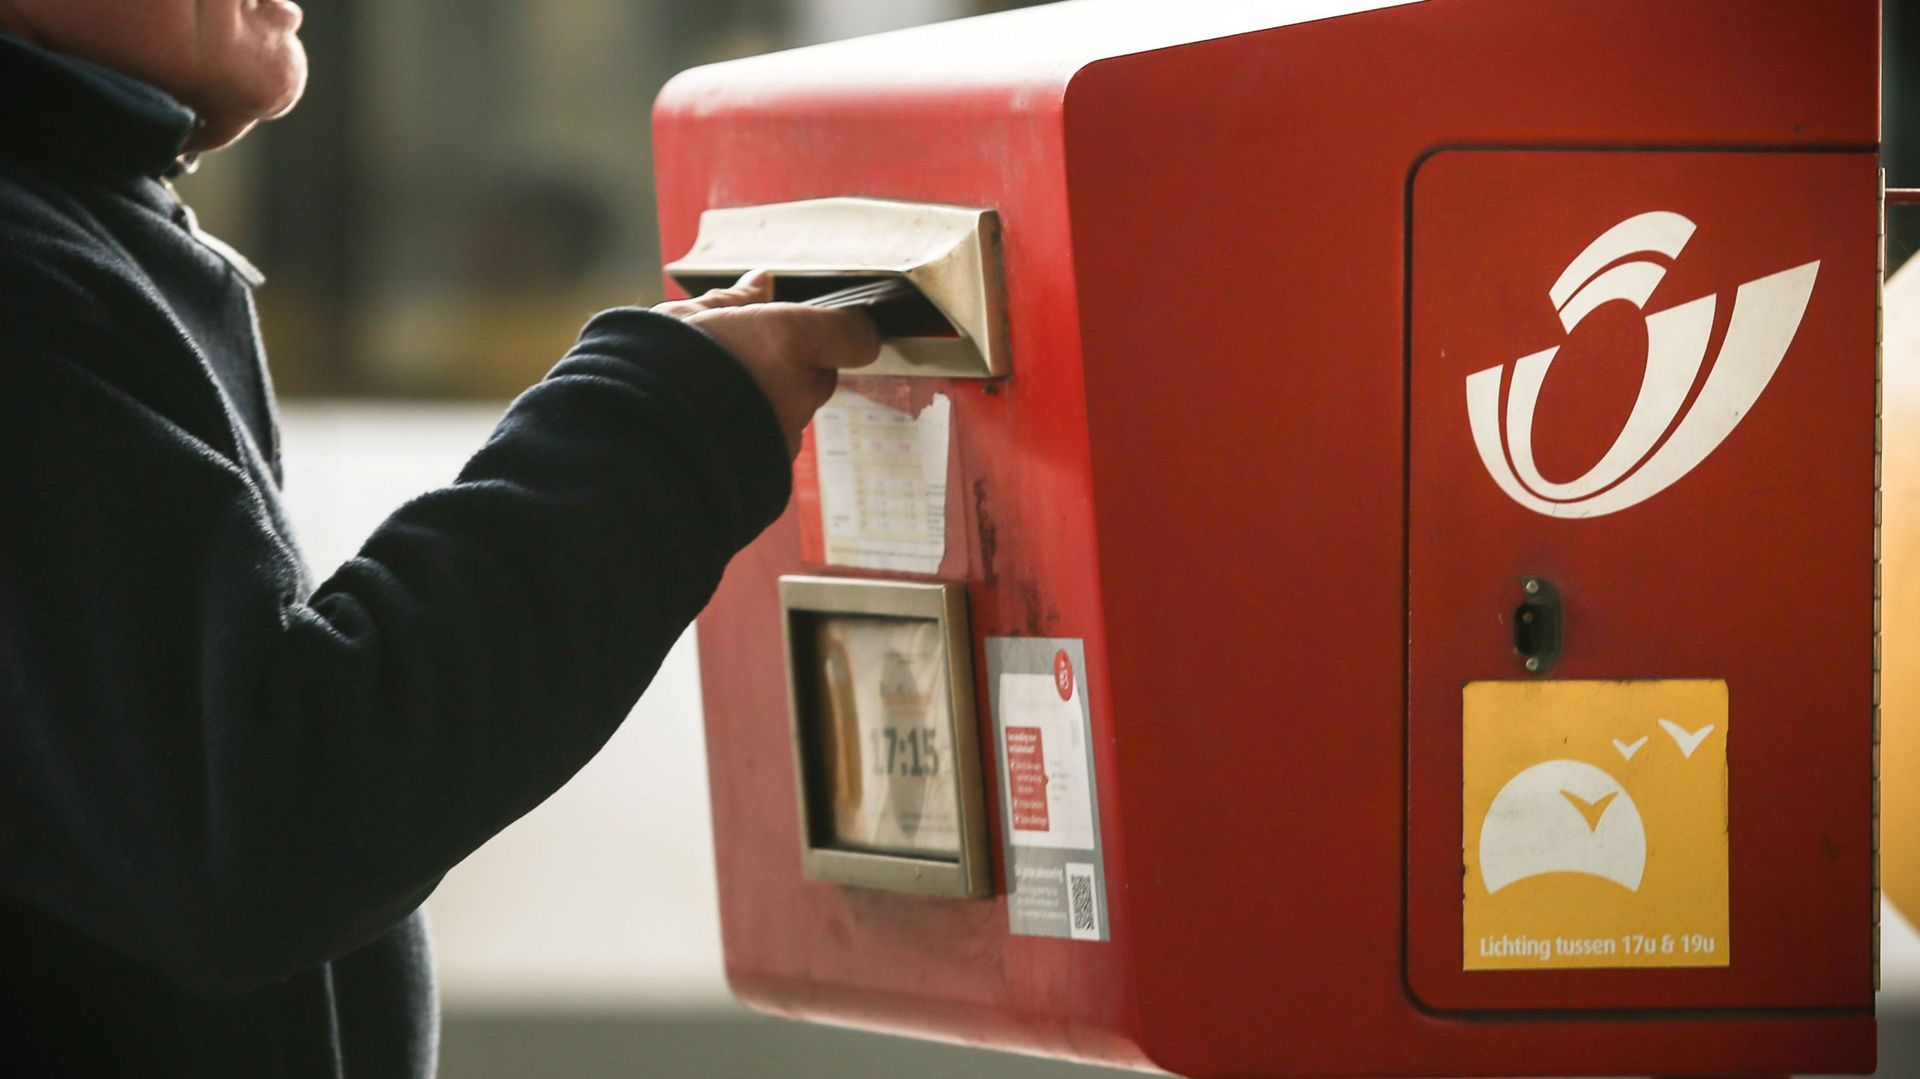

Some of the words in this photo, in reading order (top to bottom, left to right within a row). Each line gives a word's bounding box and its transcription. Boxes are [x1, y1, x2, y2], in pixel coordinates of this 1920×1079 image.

[870, 726, 940, 777] 17:15
[1480, 935, 1551, 960] Lichting
[1555, 936, 1616, 955] tussen
[1622, 934, 1656, 954] 17u
[1661, 934, 1675, 953] &
[1681, 933, 1715, 953] 19u
